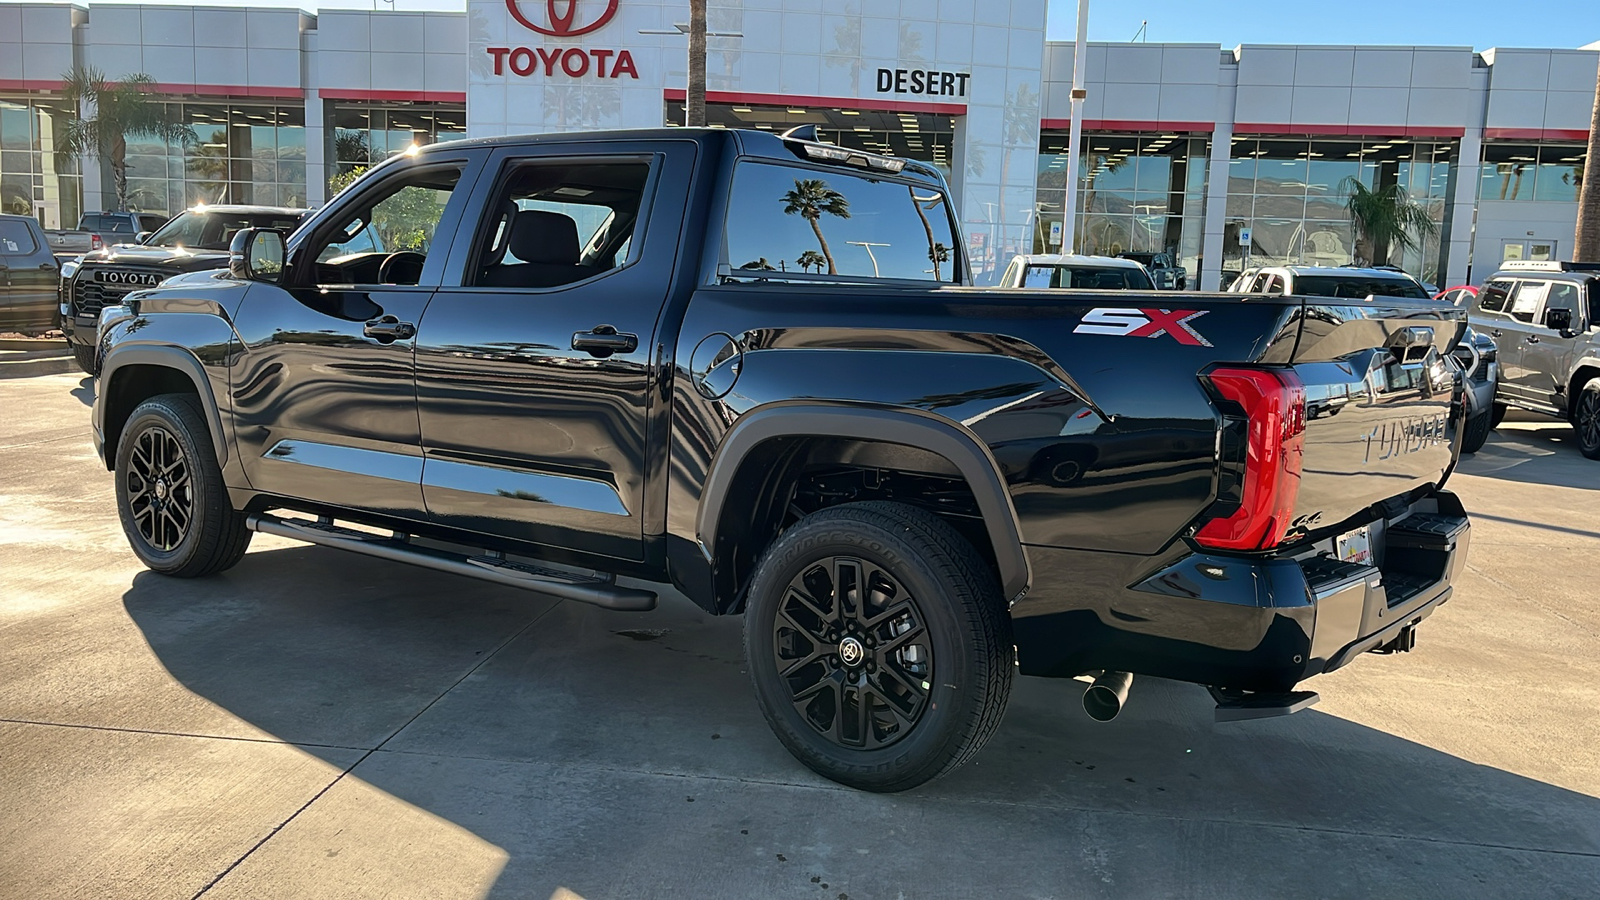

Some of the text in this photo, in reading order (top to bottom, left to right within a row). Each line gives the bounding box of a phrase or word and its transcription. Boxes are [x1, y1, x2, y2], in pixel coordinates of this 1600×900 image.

[487, 47, 639, 79] TOYOTA
[877, 68, 970, 97] DESERT
[101, 272, 157, 285] TOYOTA
[771, 530, 912, 574] BRIDGESTONE
